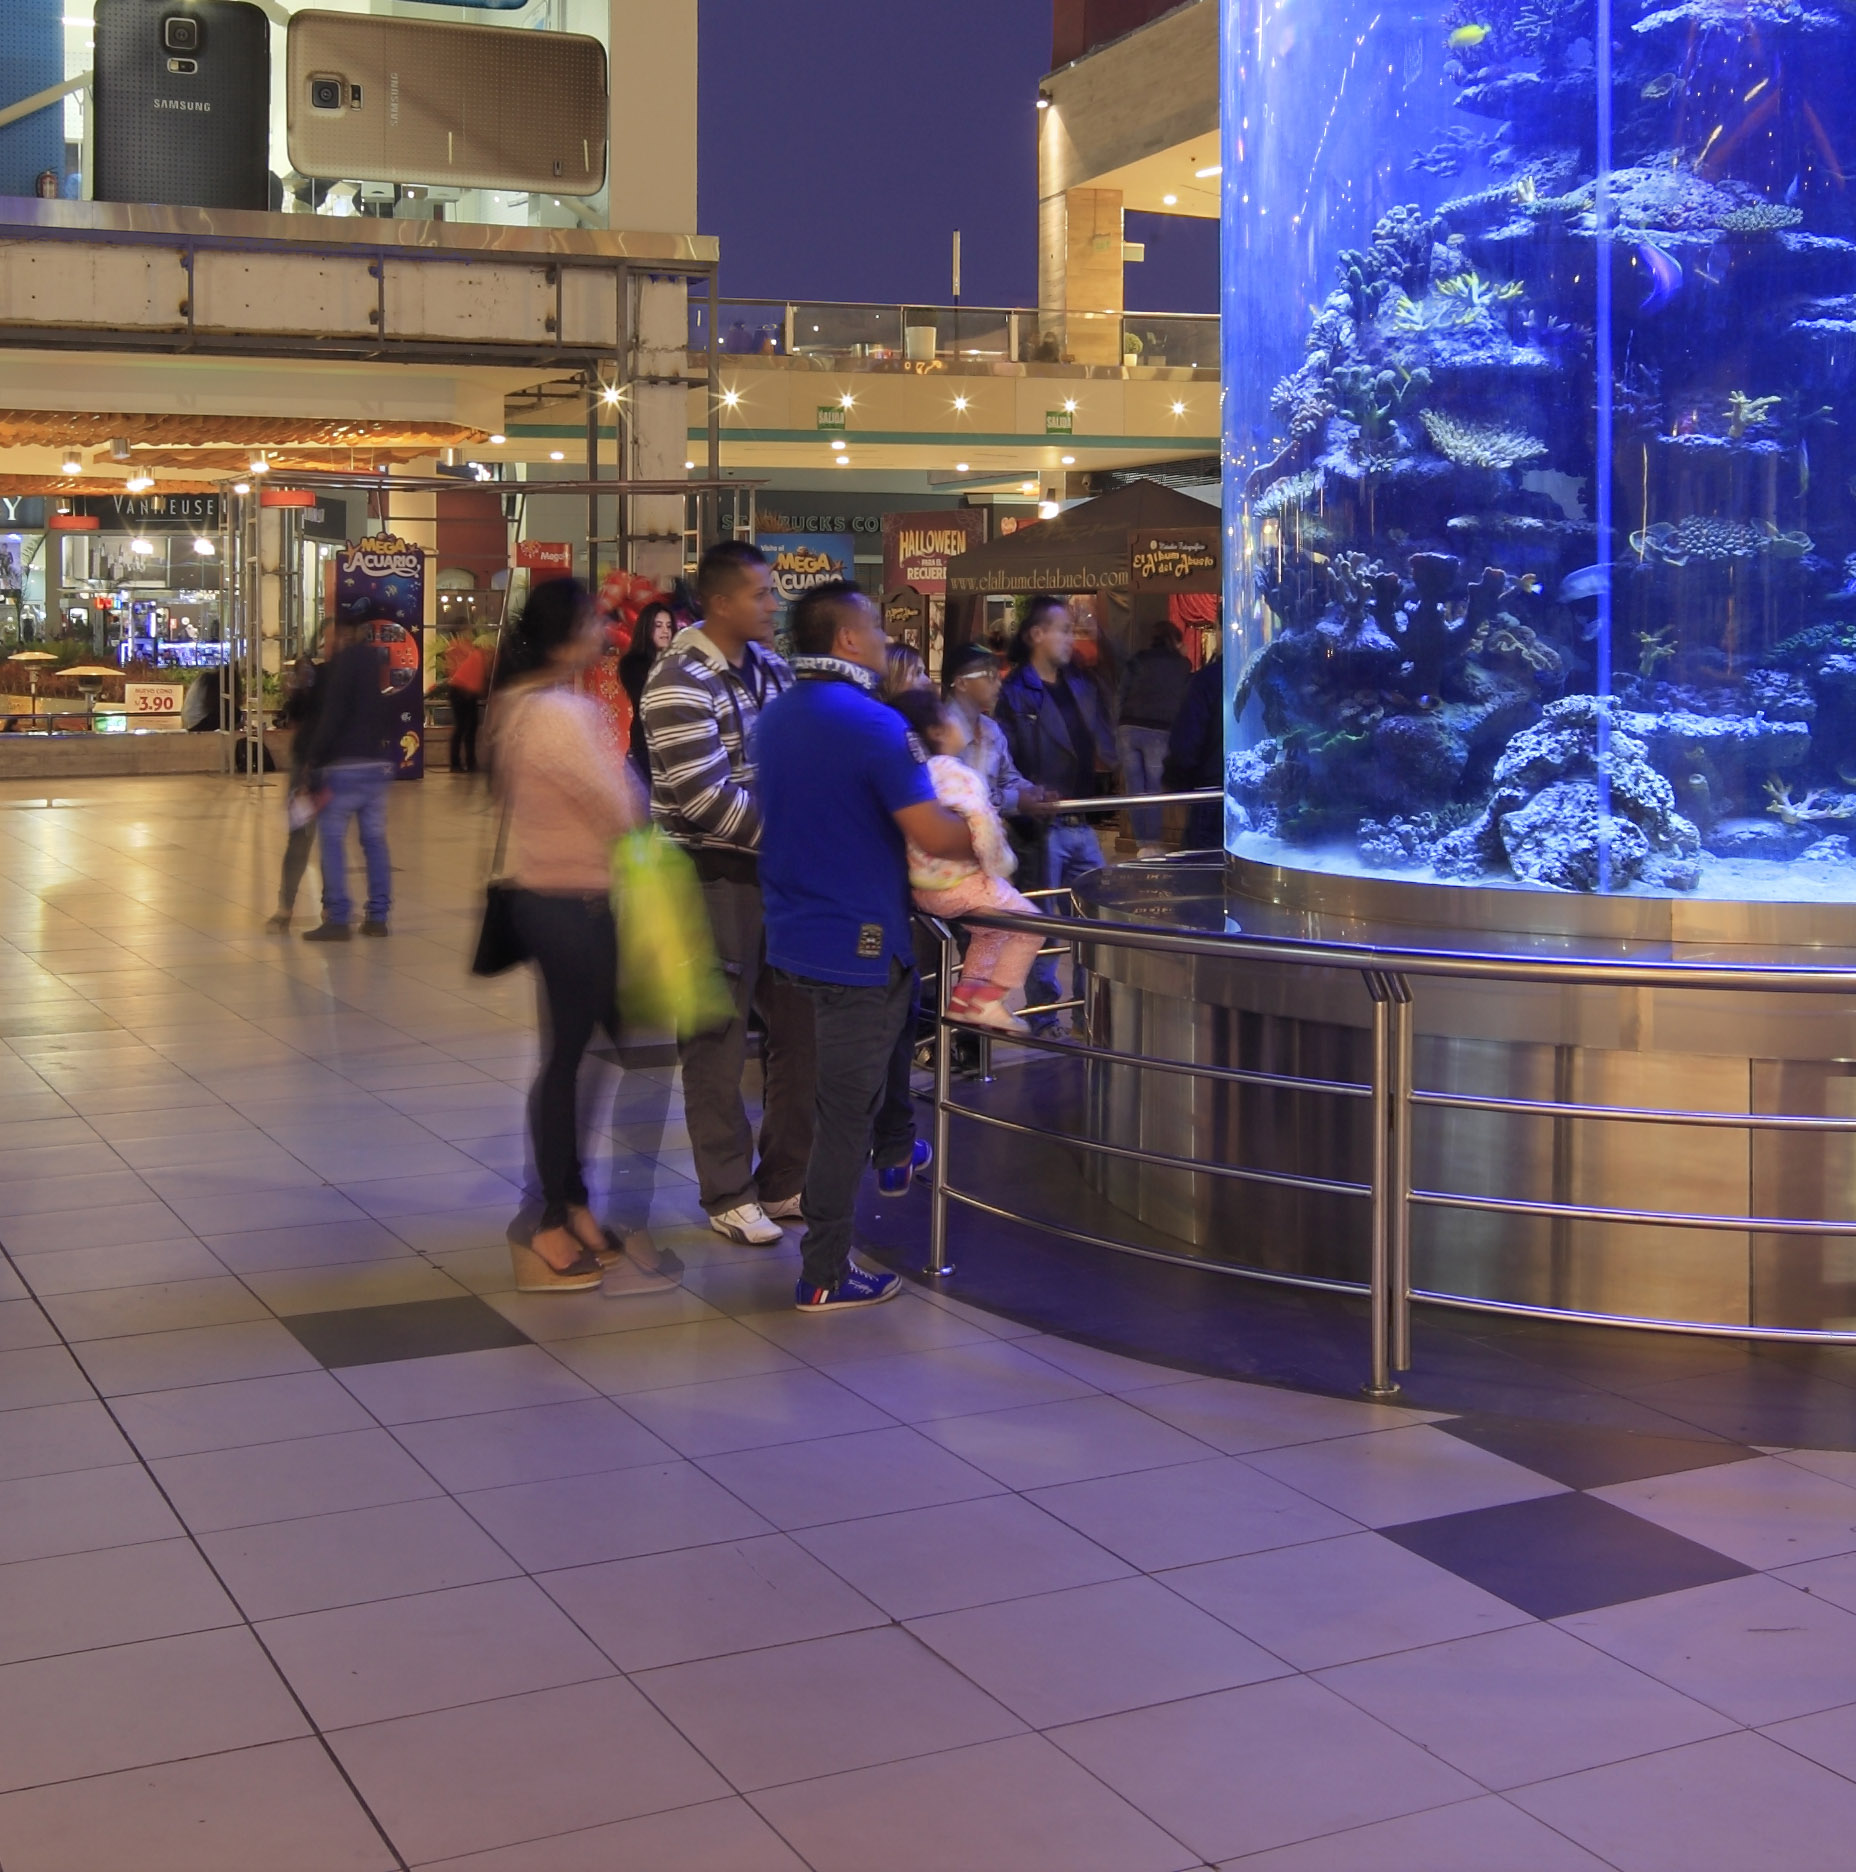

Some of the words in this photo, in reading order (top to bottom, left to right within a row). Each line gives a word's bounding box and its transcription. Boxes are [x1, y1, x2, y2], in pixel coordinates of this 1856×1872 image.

[153, 98, 211, 113] SAMSUNG
[361, 537, 407, 555] MEGA
[899, 530, 966, 564] HALLOWEEN
[344, 552, 421, 576] ACUARIO
[777, 552, 831, 574] MEGA
[907, 566, 946, 580] RECUER
